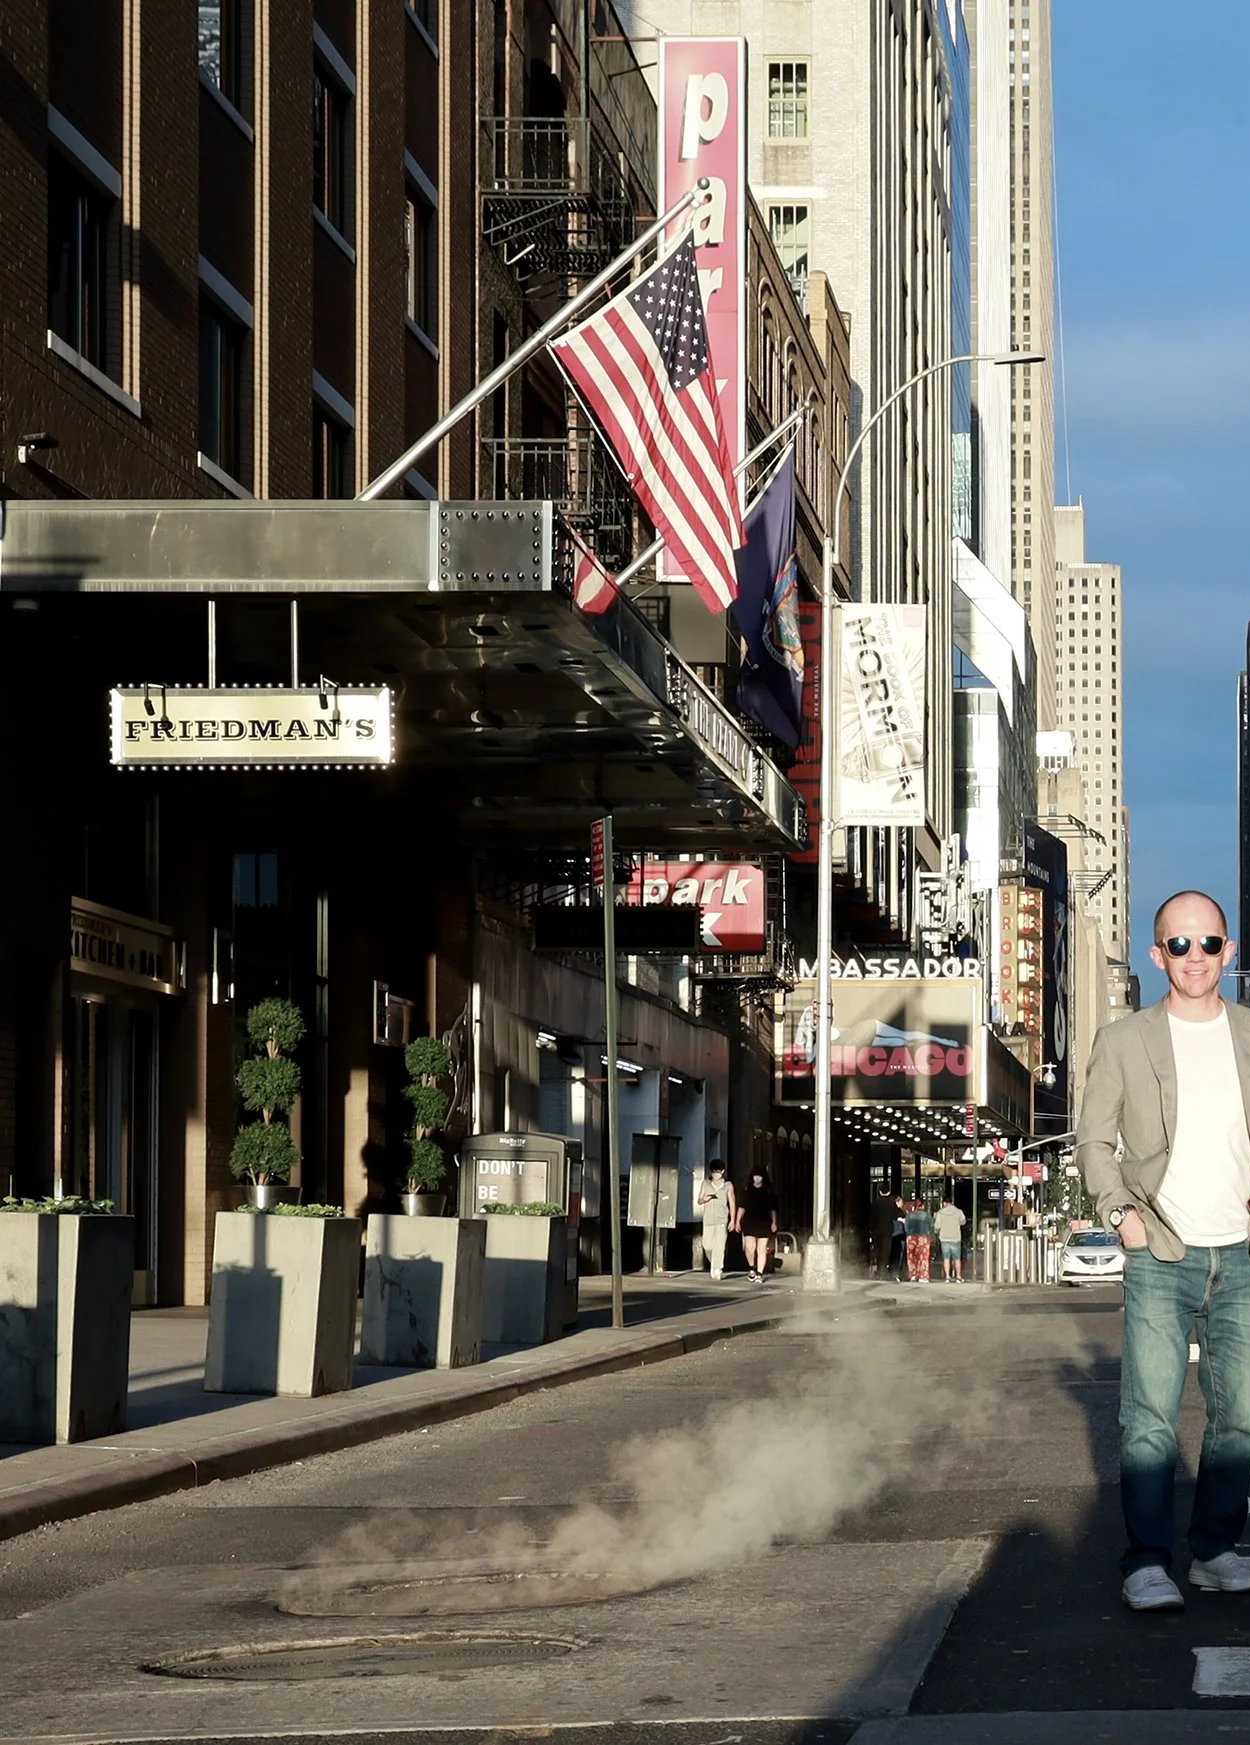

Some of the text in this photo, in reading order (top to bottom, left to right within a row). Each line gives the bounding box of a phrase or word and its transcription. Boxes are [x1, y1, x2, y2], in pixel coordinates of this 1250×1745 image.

[883, 652, 906, 702] BOOK
[897, 706, 913, 729] OF
[125, 719, 376, 742] FRIEDMAN'S
[643, 869, 753, 906] park
[479, 1160, 525, 1175] DON'T
[478, 1185, 498, 1200] BE
